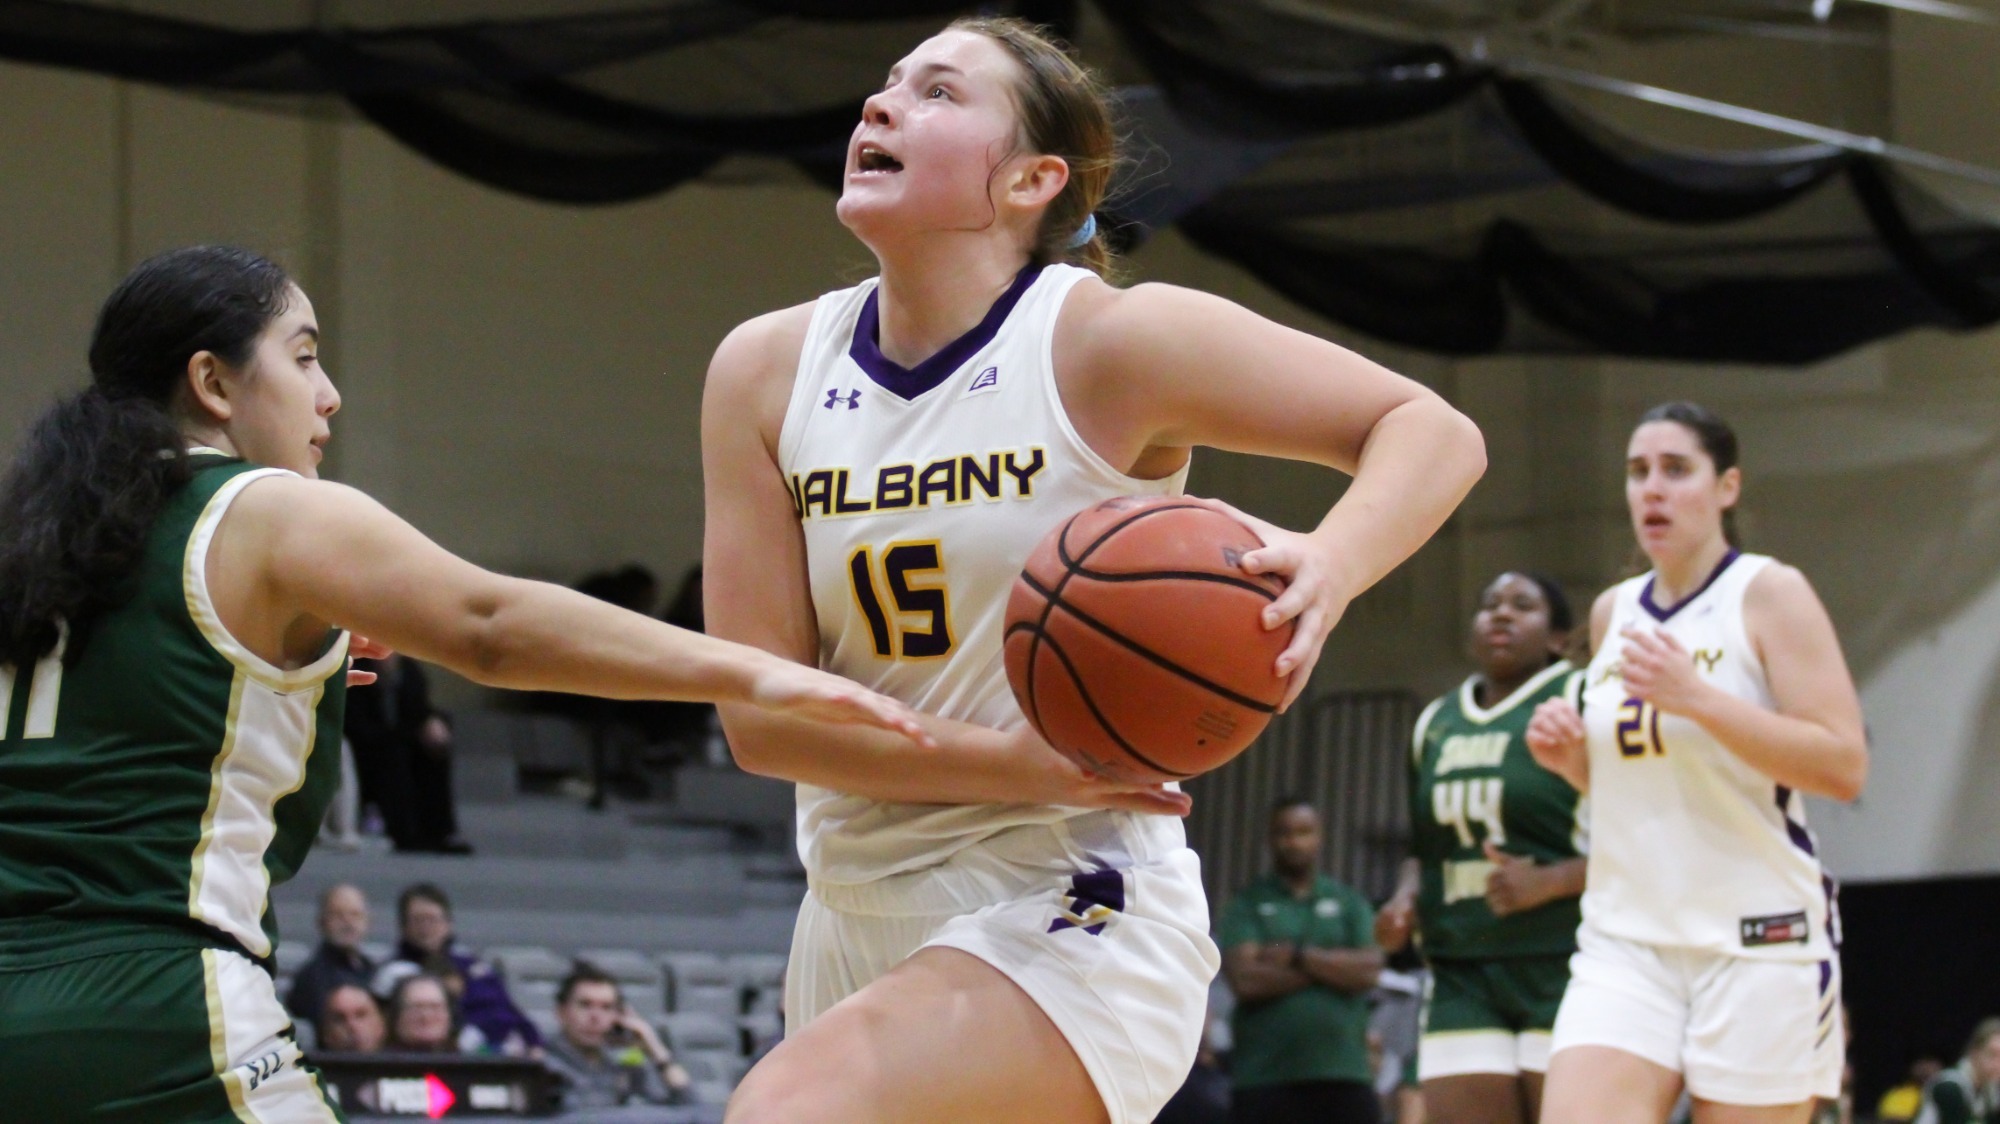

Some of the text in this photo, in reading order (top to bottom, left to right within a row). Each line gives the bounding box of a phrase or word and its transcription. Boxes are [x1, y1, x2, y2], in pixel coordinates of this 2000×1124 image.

[847, 538, 957, 662] 15
[1615, 697, 1666, 760] 21
[1432, 777, 1508, 848] 44
